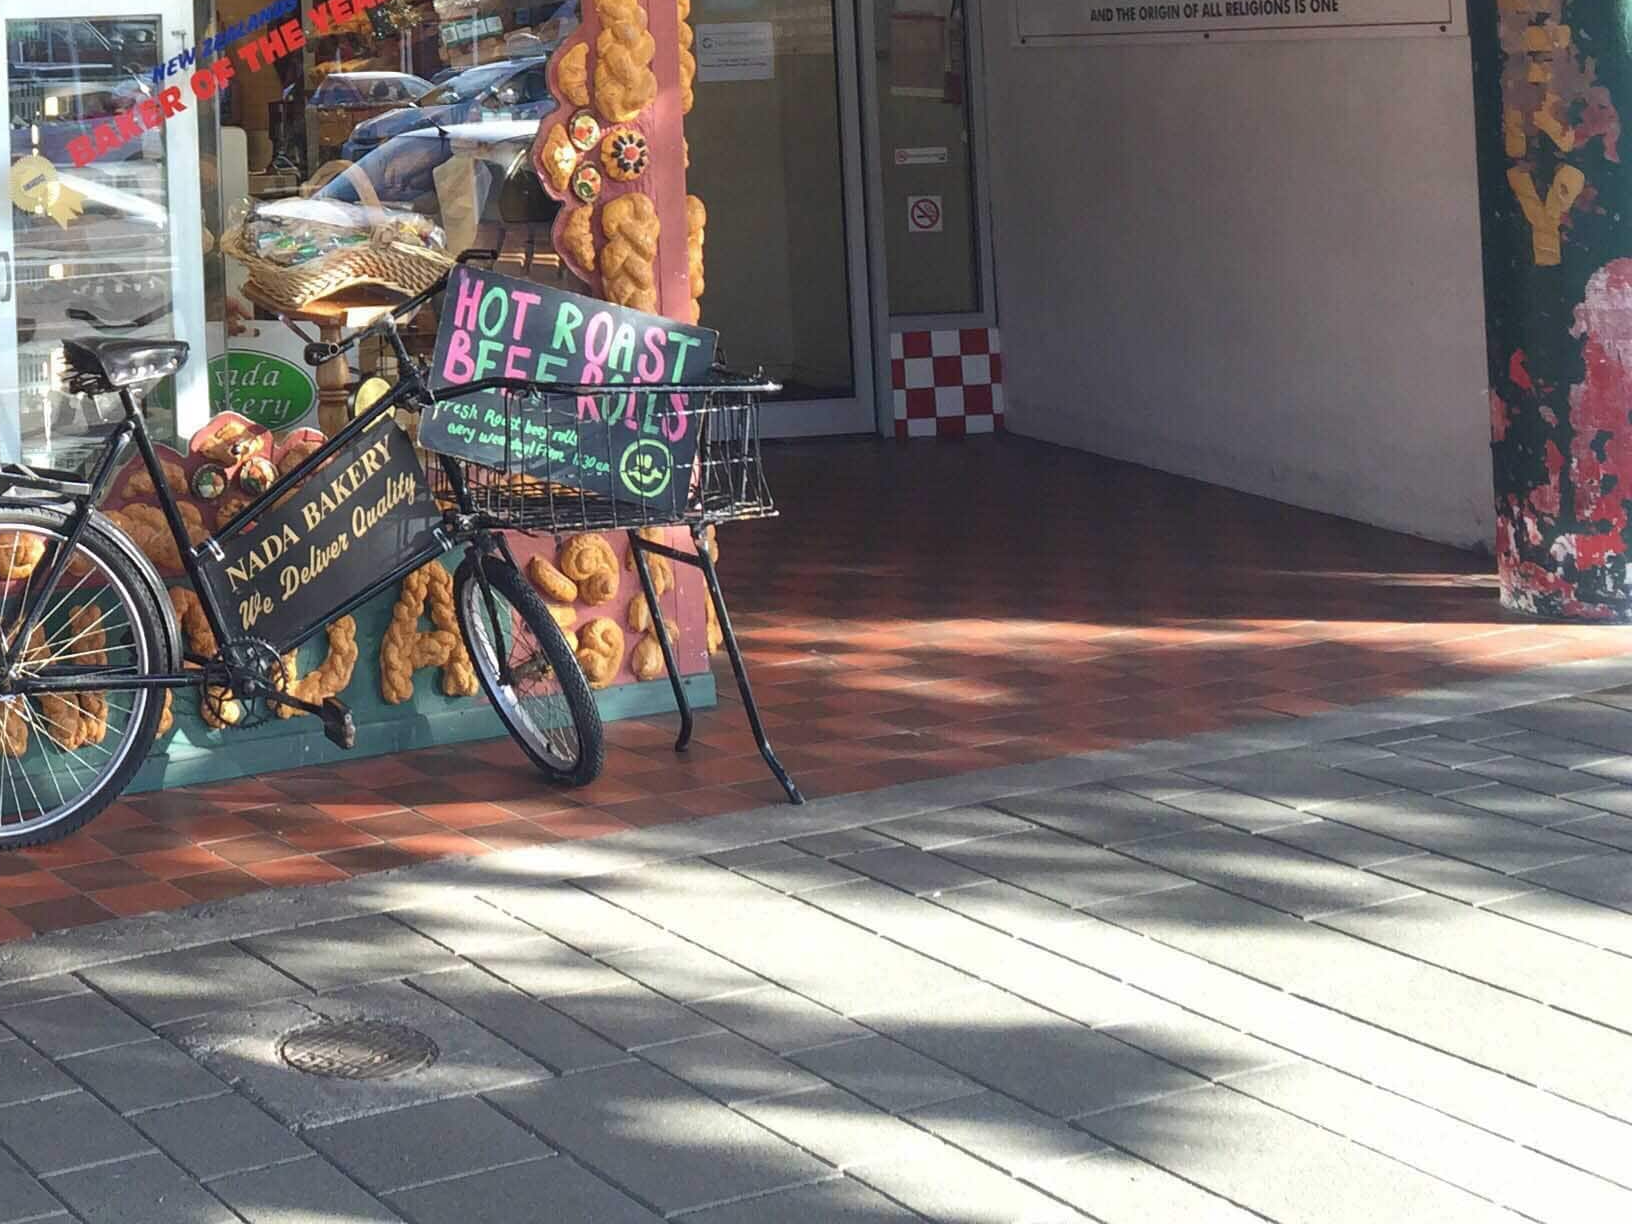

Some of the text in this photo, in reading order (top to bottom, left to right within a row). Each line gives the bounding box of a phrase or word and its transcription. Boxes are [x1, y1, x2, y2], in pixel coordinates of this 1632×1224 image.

[1090, 7, 1114, 23] AND
[1117, 6, 1137, 22] THE
[1139, 3, 1181, 21] ORIGIN
[1184, 2, 1199, 19] OF
[1201, 1, 1223, 18] ALL
[65, 85, 188, 169] BAKER
[190, 57, 235, 101] OF
[237, 22, 308, 74] THE
[152, 48, 196, 84] NEW
[443, 329, 568, 405] BEEF
[454, 278, 702, 384] HOT ROAST
[225, 434, 393, 592] NADA BAKERY
[239, 472, 416, 631] We Deliver Quality
